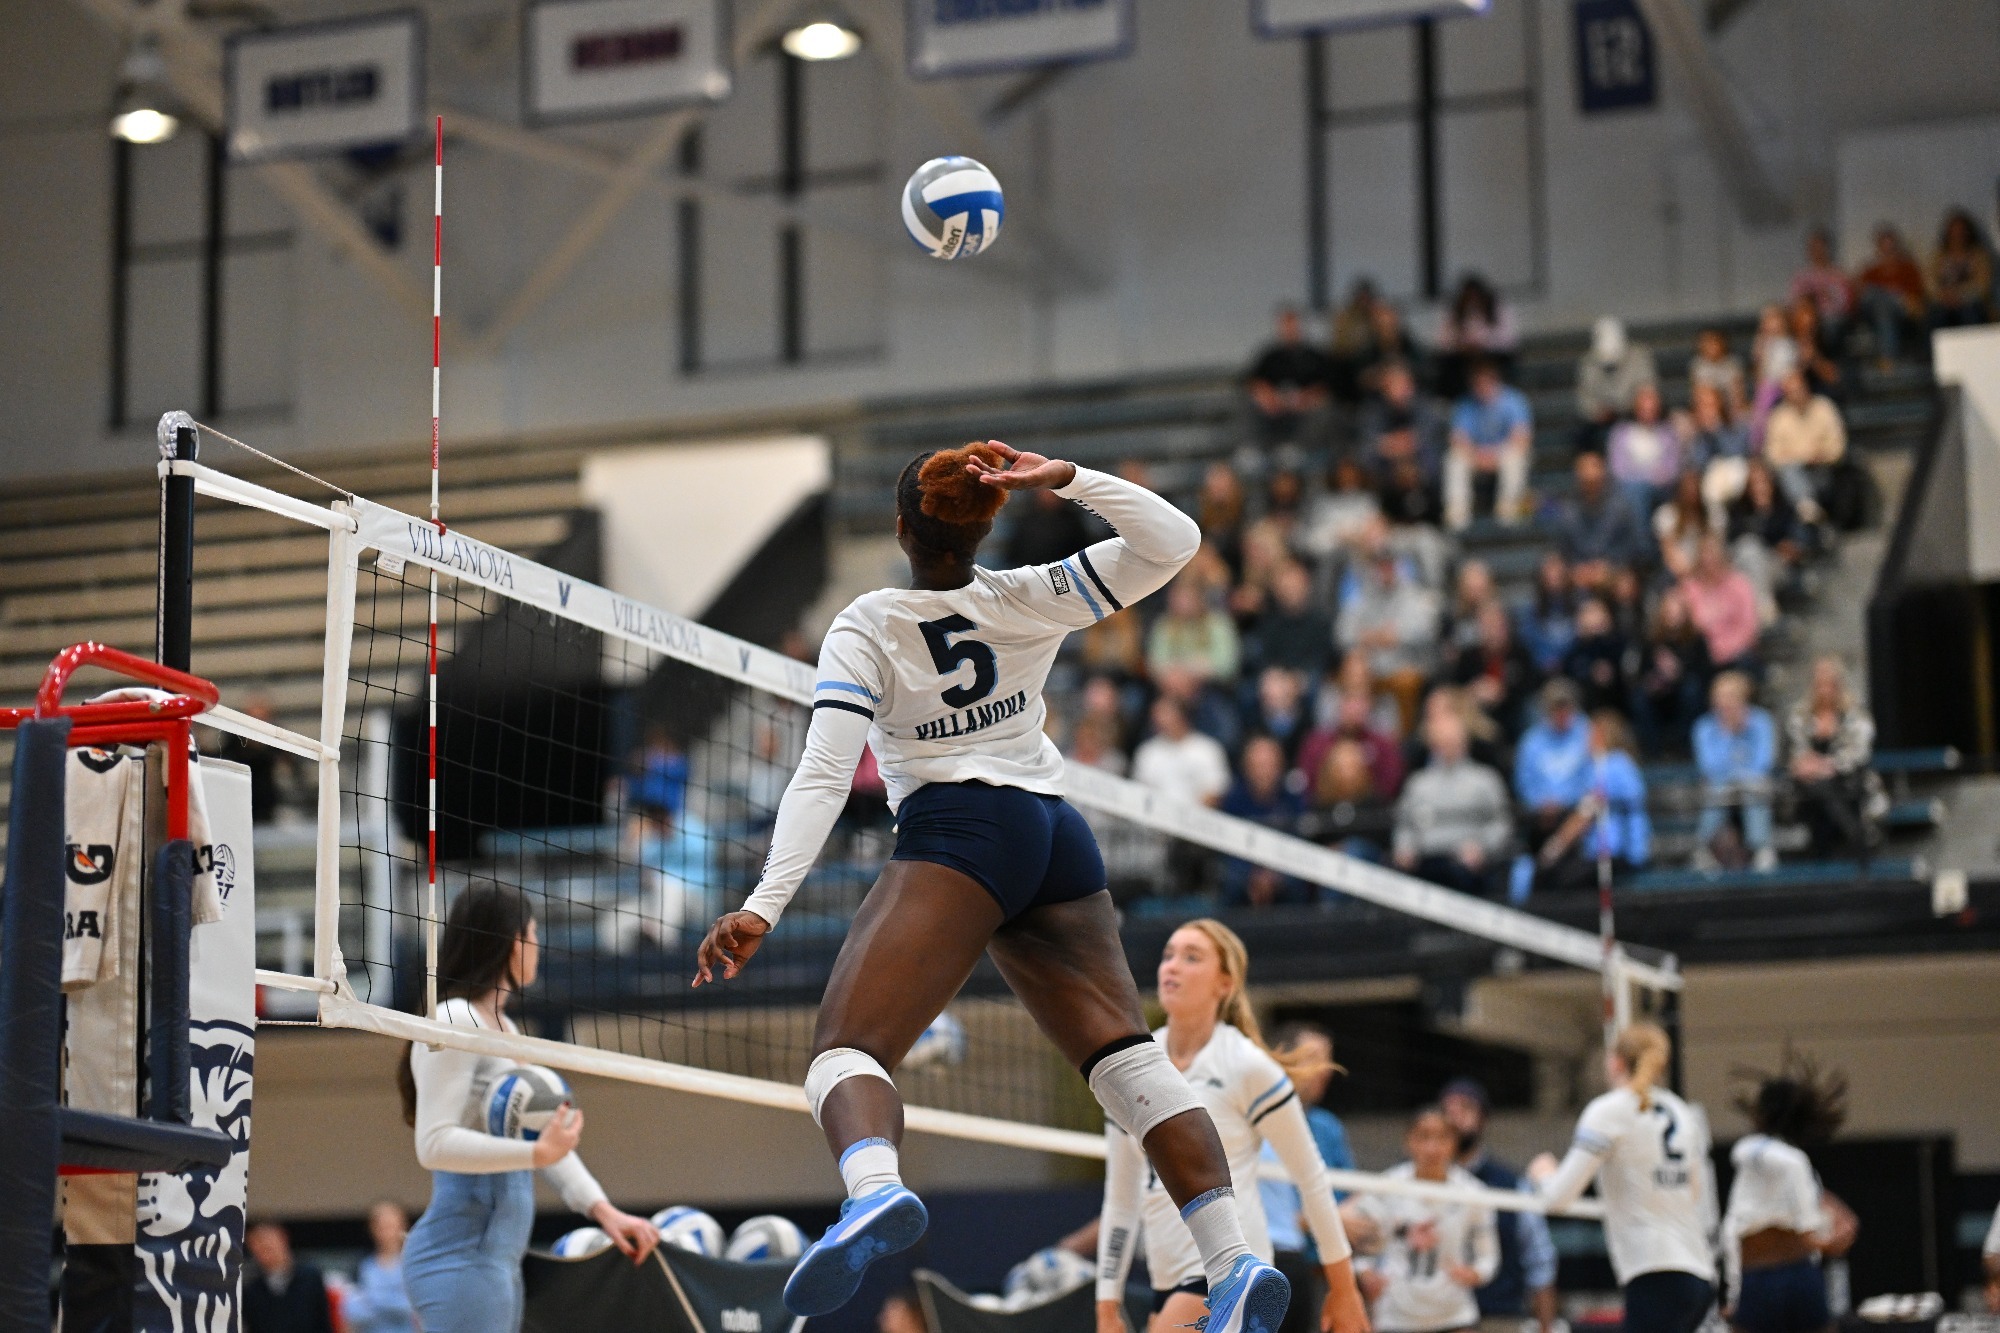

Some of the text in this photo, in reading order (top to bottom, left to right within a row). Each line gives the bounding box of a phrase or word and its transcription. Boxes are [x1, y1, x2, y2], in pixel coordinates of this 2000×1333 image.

[408, 522, 513, 589] VILLANOVA
[611, 598, 702, 659] VILLANOVA
[917, 613, 998, 709] 5
[915, 689, 1027, 740] VILLANOVA
[1653, 1103, 1684, 1161] 2
